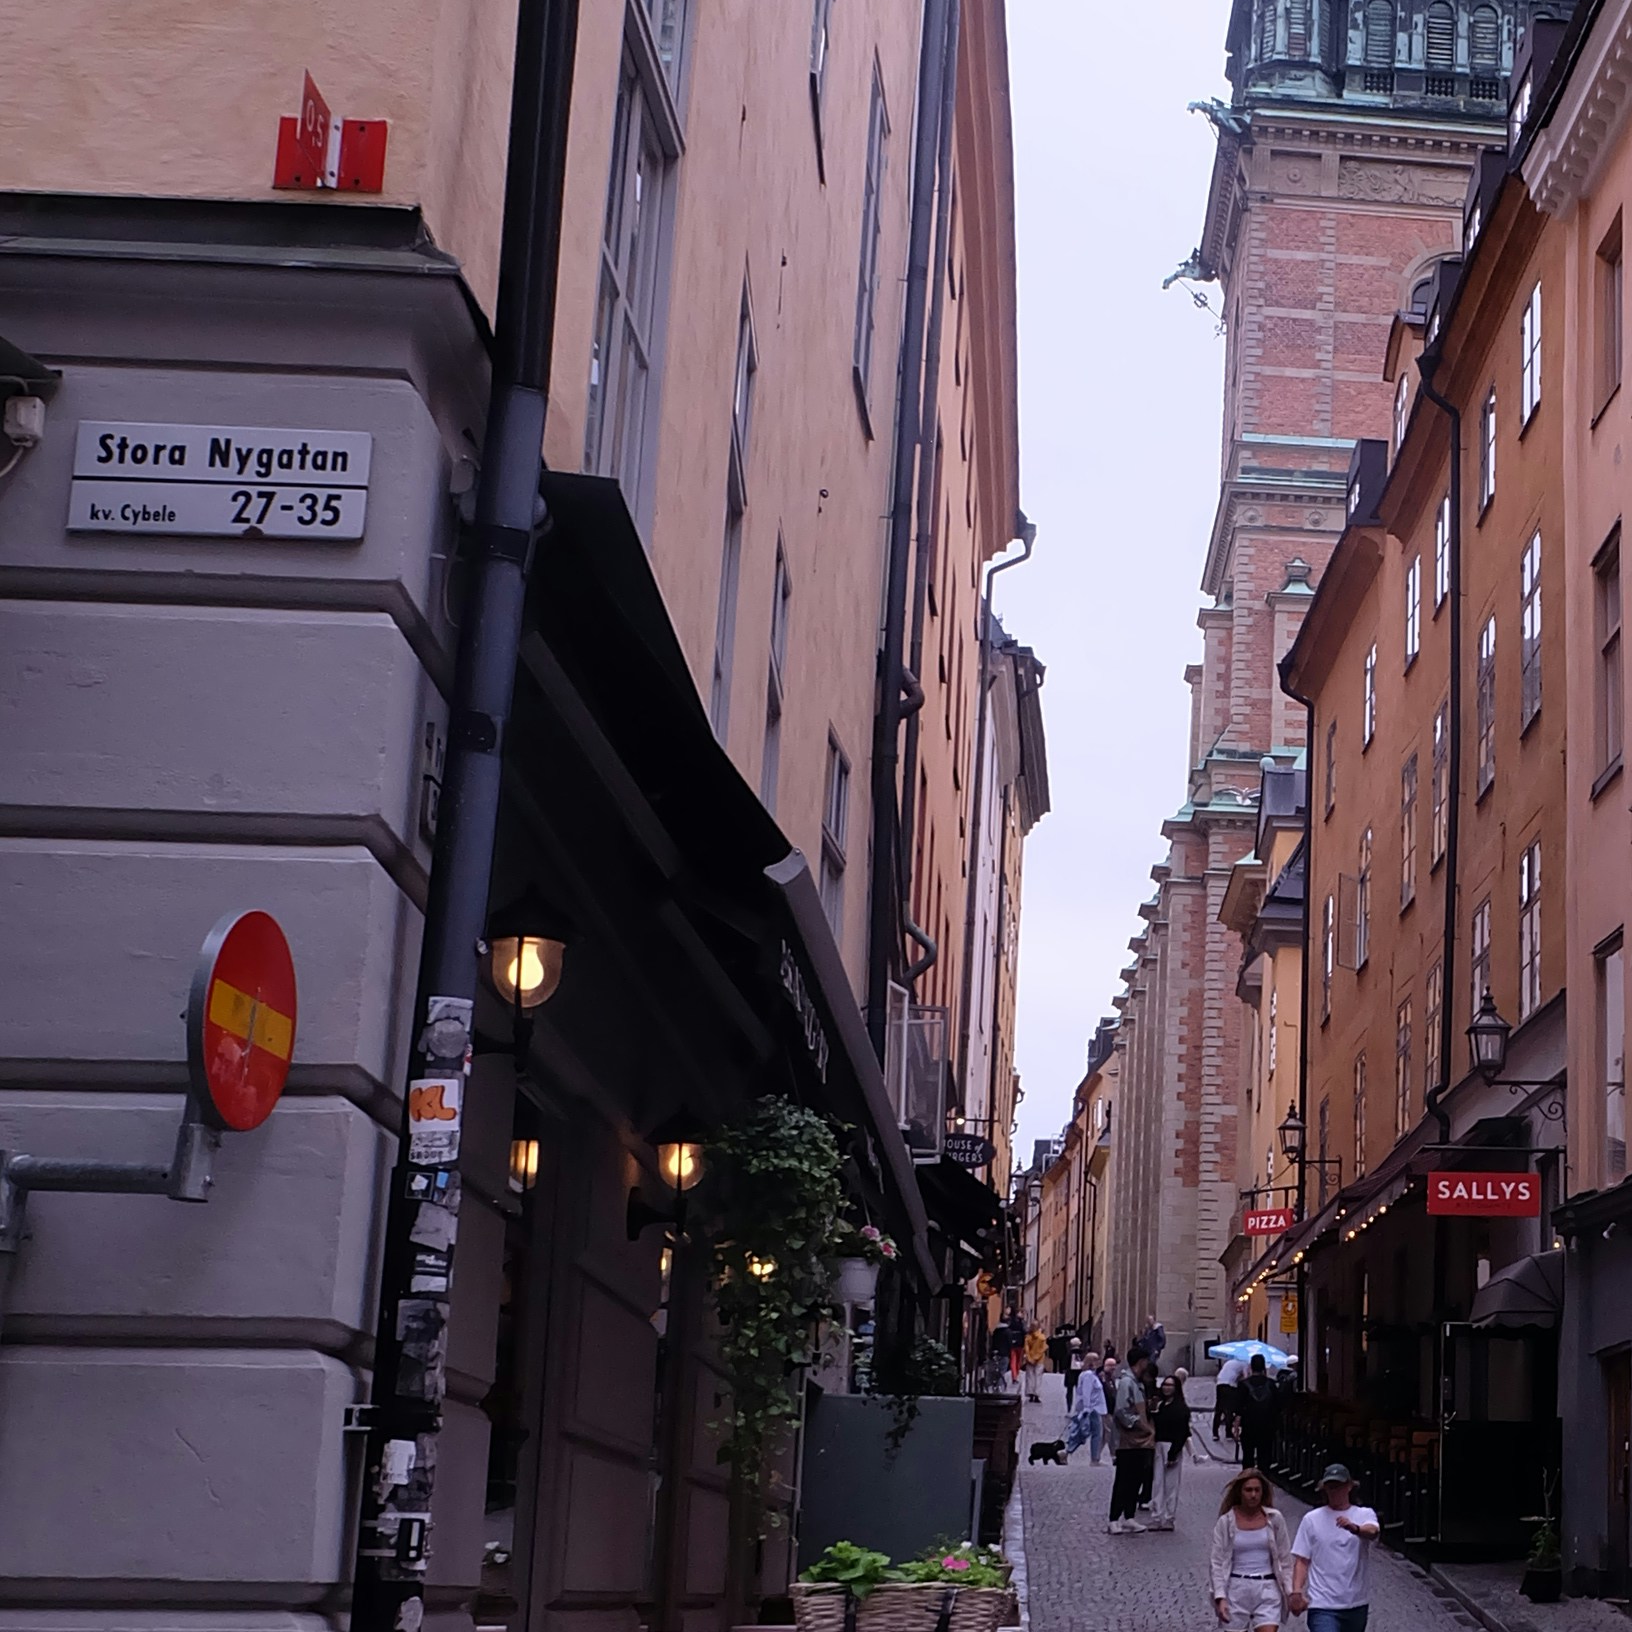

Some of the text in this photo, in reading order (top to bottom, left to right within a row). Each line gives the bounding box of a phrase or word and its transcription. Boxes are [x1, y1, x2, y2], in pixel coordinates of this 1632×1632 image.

[97, 433, 349, 478] Stora Nygatan
[89, 490, 343, 526] kv. Cybele 27-35
[1438, 1180, 1531, 1201] SALLYS
[1247, 1214, 1286, 1230] PIZZA
